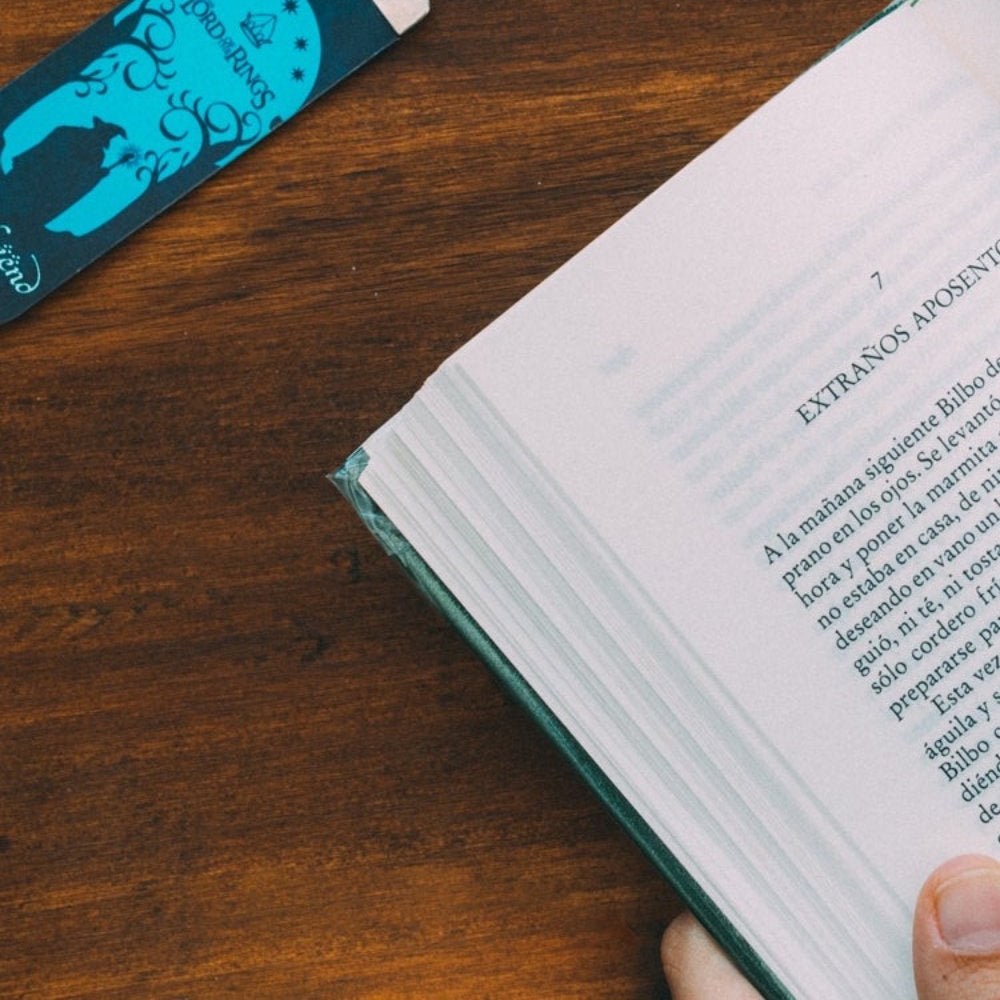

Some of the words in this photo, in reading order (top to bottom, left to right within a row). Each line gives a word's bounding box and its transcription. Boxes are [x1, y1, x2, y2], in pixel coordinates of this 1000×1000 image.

[224, 46, 276, 110] RINGS
[870, 271, 883, 290] 7
[796, 324, 910, 425] EXTRAÑOS
[763, 545, 783, 565] A
[776, 532, 801, 551] la
[799, 477, 866, 536] mañana
[865, 414, 940, 481] siguiente
[935, 376, 985, 418] Bilbo
[796, 571, 841, 608] hora
[839, 558, 854, 580] y
[855, 515, 905, 567] poner
[902, 501, 927, 519] la
[926, 440, 998, 503] marmita
[853, 634, 900, 677] guió,
[897, 616, 919, 637] ni
[917, 596, 944, 619] té,
[942, 579, 964, 600] ni
[889, 641, 977, 722] prepararse
[938, 740, 990, 782] Bilbo
